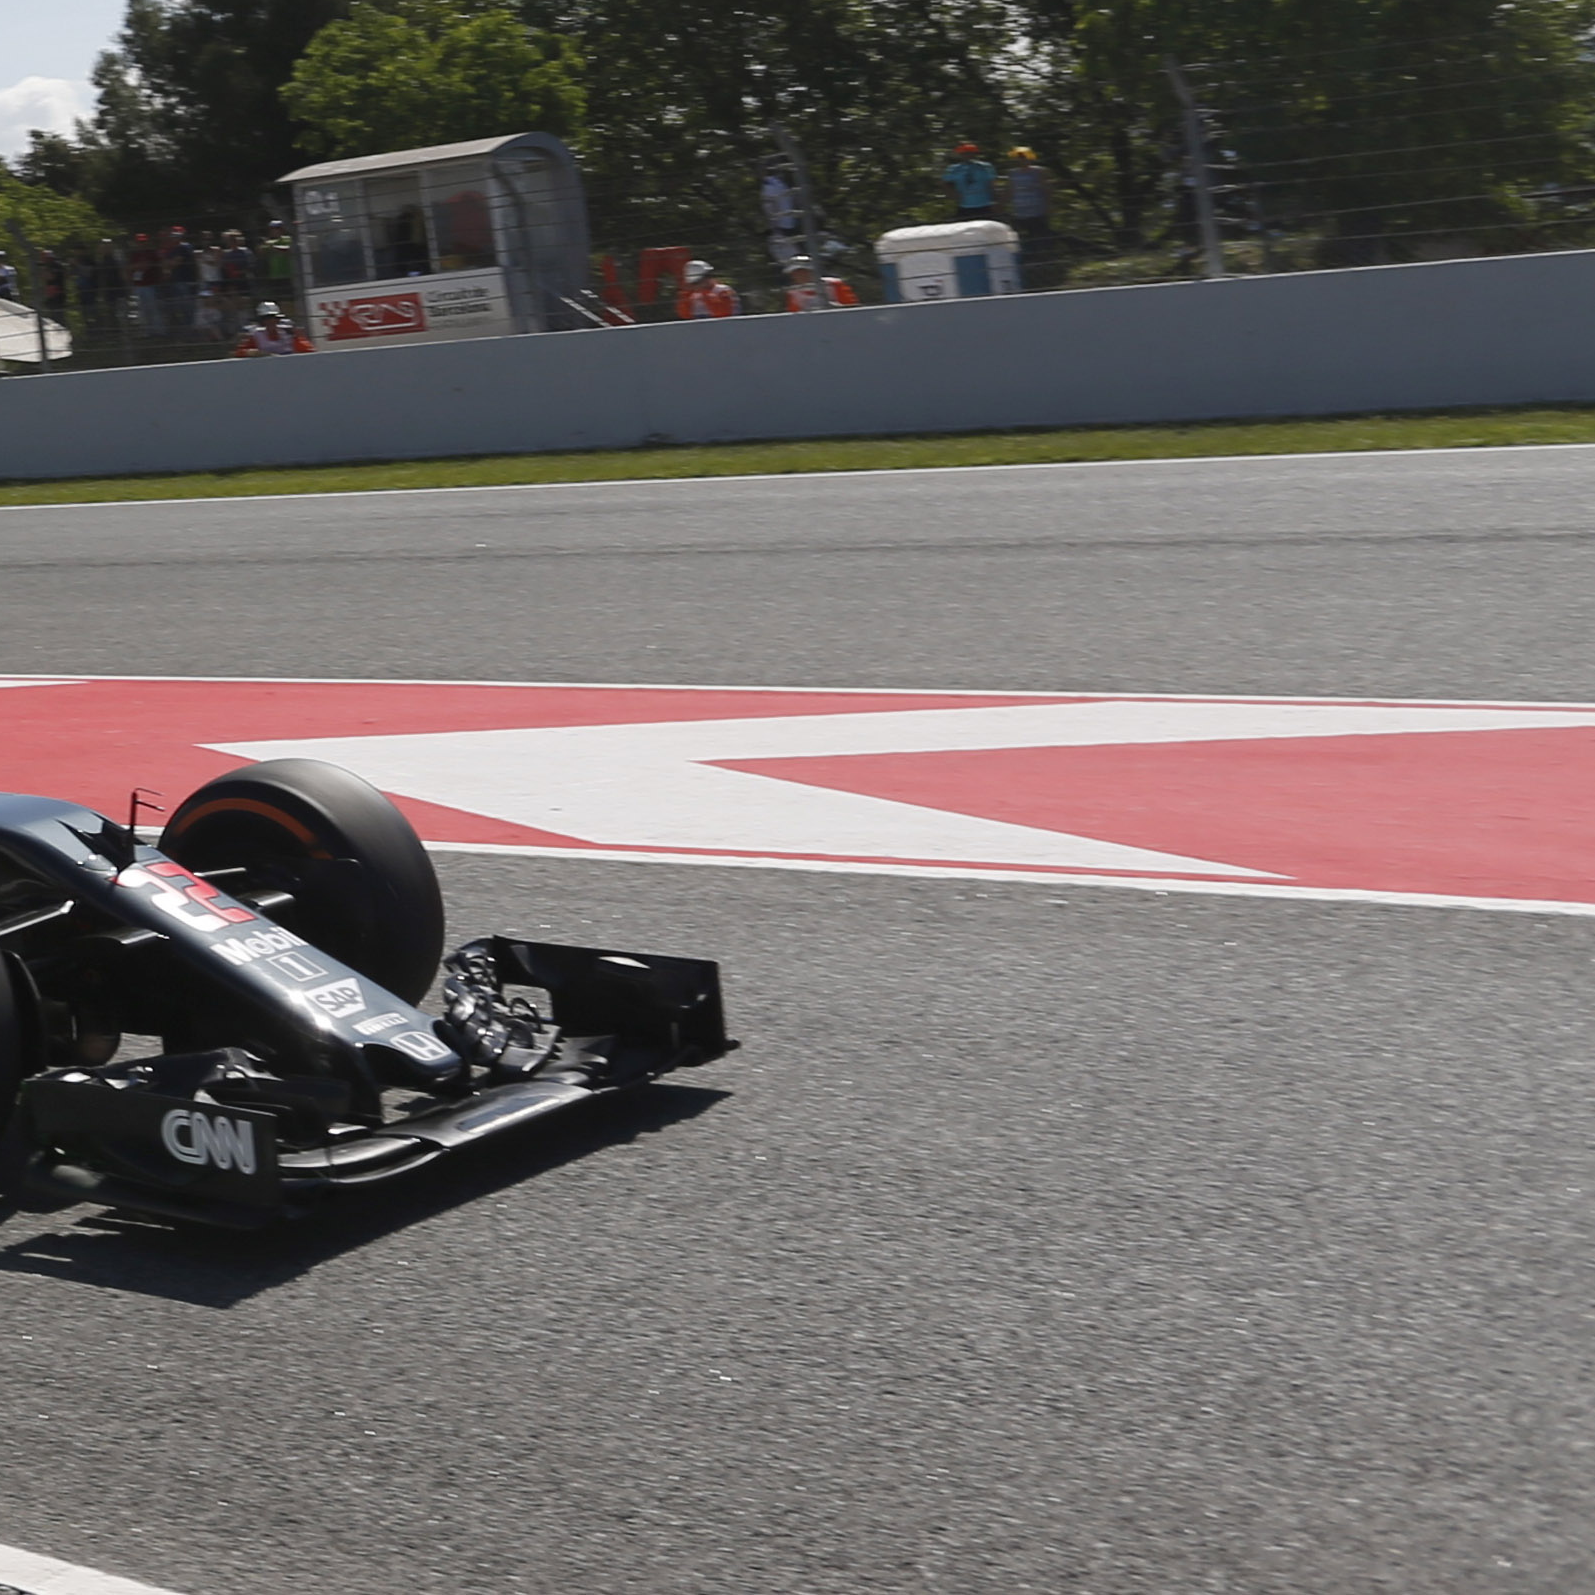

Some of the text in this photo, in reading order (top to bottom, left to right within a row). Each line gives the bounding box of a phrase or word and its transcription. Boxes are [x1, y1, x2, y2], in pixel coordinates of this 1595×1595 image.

[116, 861, 259, 932] 22
[210, 926, 310, 966] Mobil
[315, 986, 361, 1012] SAP
[161, 1108, 257, 1175] CNN
